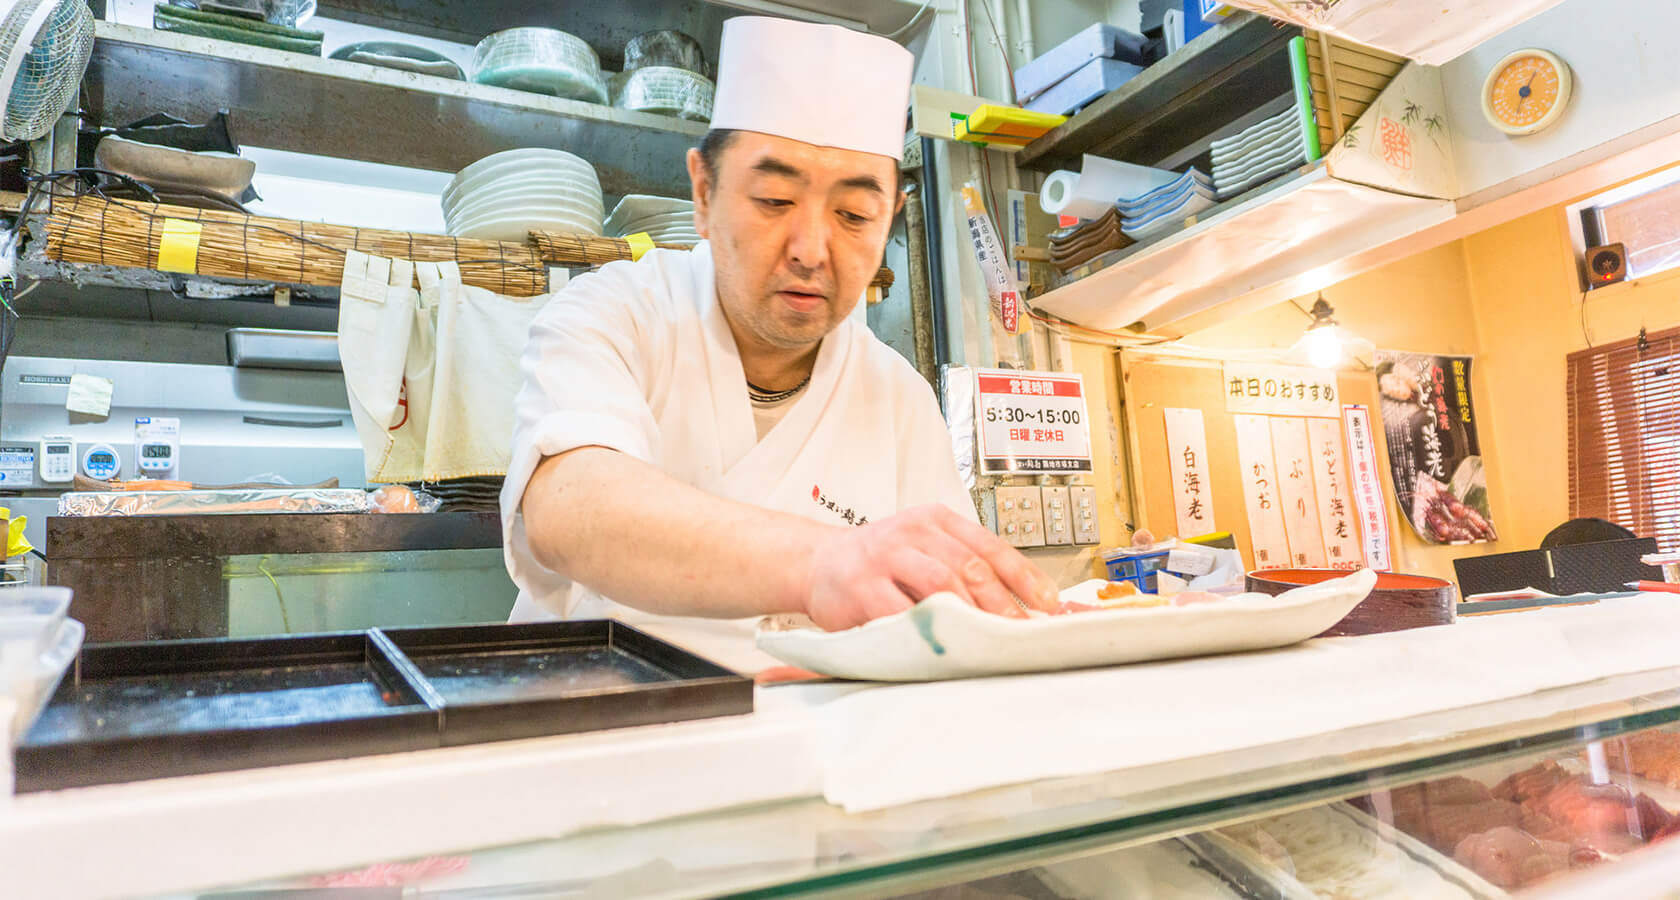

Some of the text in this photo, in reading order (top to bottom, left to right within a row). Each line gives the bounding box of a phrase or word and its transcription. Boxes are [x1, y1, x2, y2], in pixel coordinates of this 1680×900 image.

[1009, 379, 1054, 395] 営業時間
[1229, 375, 1335, 402] 本日のおすすめ
[1452, 360, 1472, 423] 数量限定
[986, 407, 1080, 425] 5:30~15:00
[1009, 428, 1065, 442] 日曜 定休日
[1183, 445, 1203, 520] 白海老
[1252, 462, 1271, 510] かつお
[1289, 457, 1307, 518] ぶり
[1322, 441, 1349, 539] ぶどう海老
